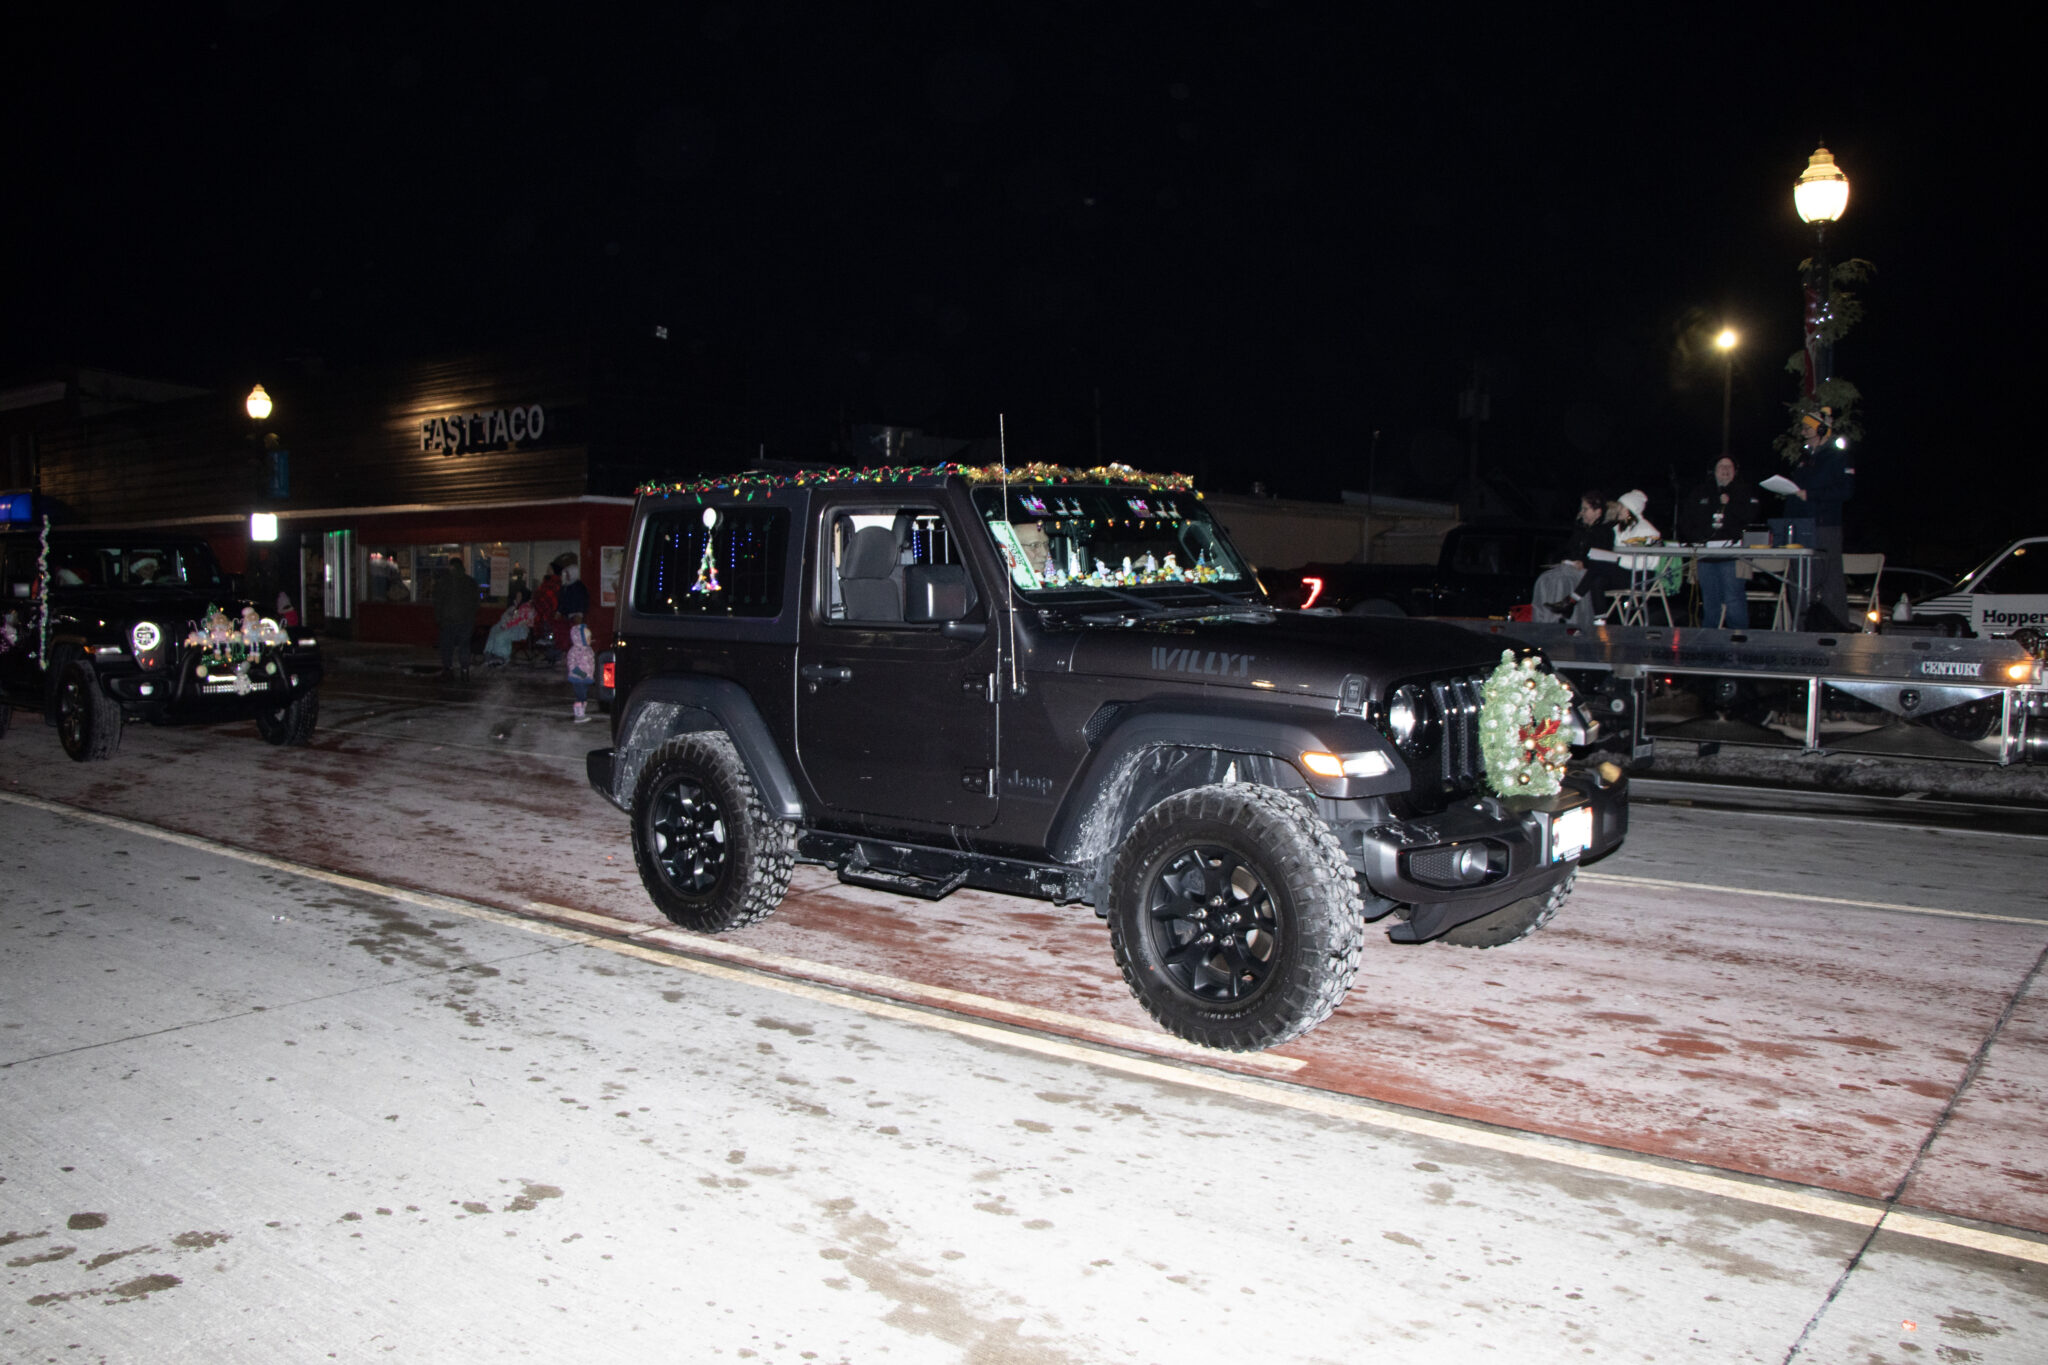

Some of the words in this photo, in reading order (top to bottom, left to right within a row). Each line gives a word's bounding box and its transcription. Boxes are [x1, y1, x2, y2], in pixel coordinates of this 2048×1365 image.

[420, 414, 472, 451] FAST
[482, 404, 545, 444] TACO
[1151, 647, 1256, 677] WILLYS
[1921, 661, 1982, 677] CENTURY
[1008, 769, 1053, 796] Jeep
